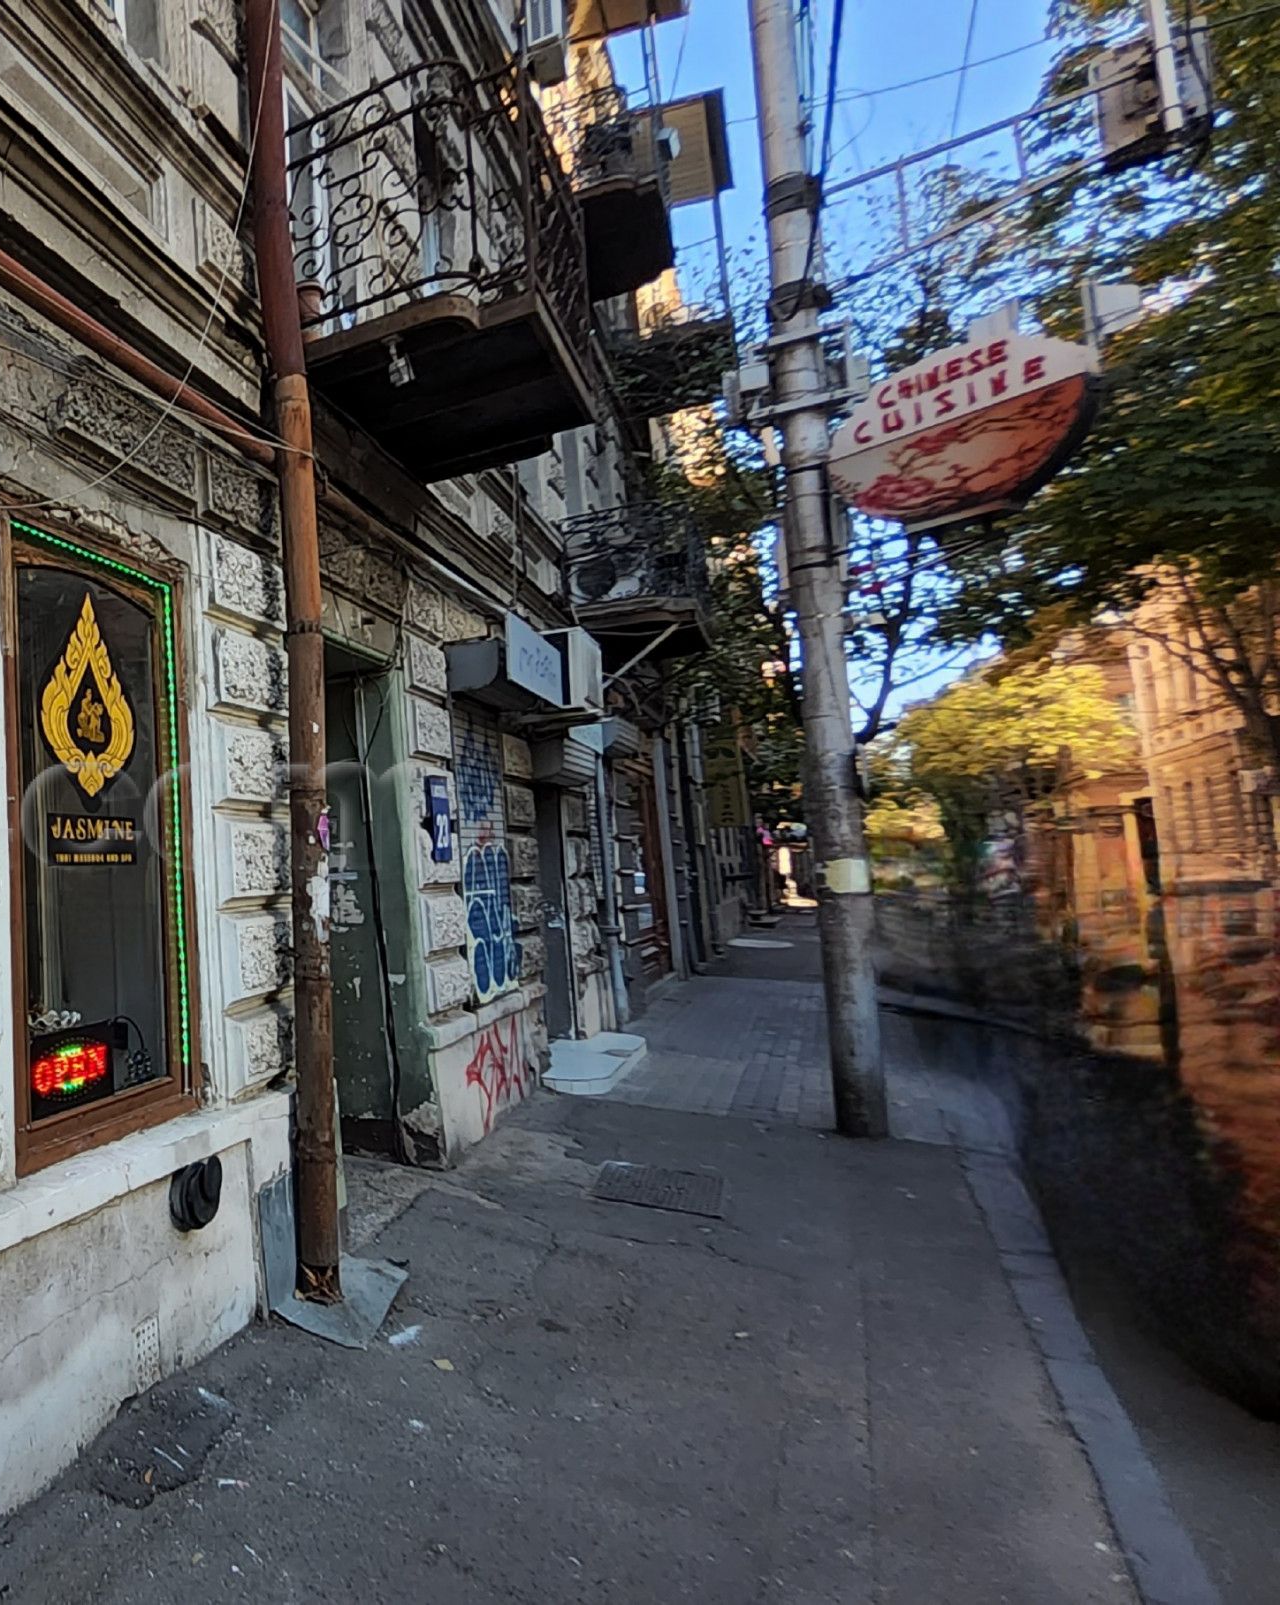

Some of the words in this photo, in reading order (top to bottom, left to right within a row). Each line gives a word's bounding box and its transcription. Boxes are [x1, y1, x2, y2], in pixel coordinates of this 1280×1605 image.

[853, 355, 1046, 444] CUISINE
[876, 339, 1009, 410] CHINESE
[51, 816, 134, 841] JASMINE
[33, 1042, 108, 1093] OPEN
